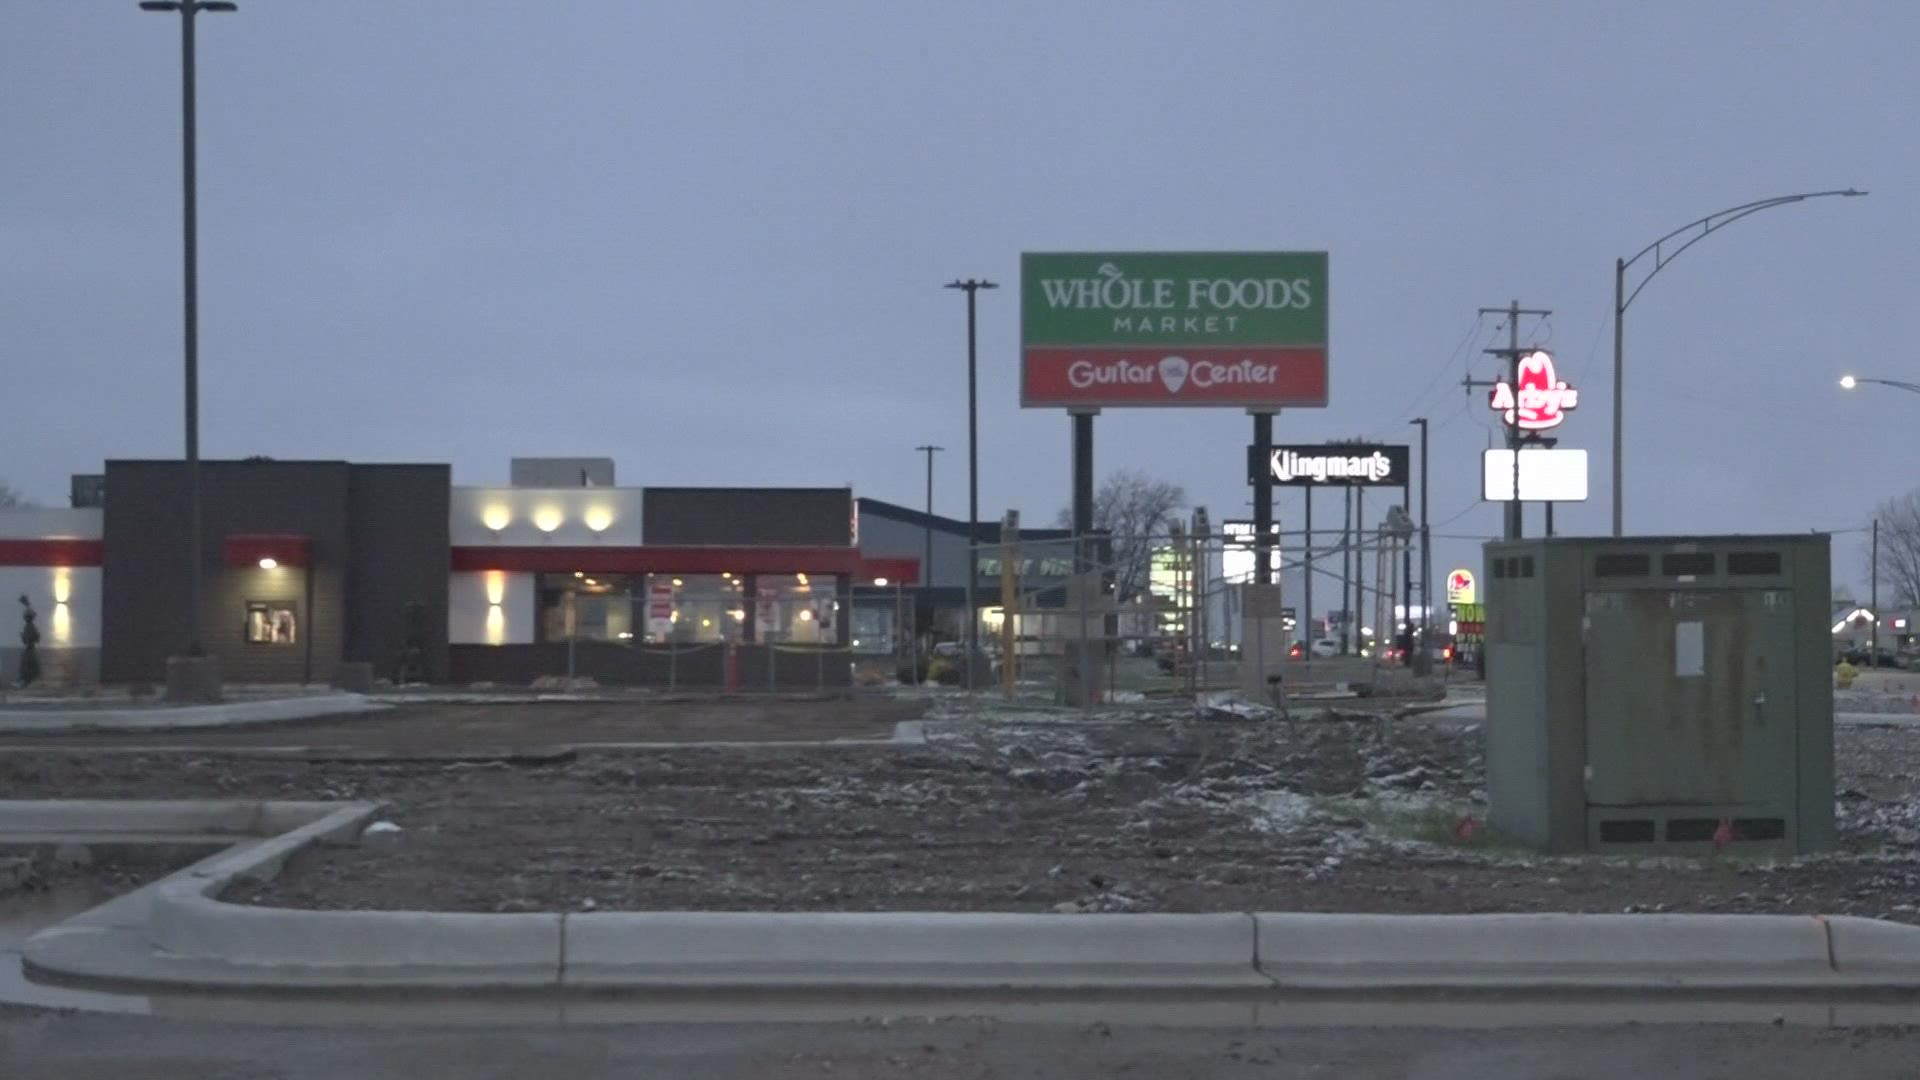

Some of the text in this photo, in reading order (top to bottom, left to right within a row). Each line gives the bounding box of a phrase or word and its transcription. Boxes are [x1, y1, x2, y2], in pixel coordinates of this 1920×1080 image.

[1040, 276, 1311, 310] WHOLE FOODS
[1113, 316, 1240, 333] MARKET
[1067, 359, 1278, 389] Guitar Center
[1270, 449, 1391, 482] Klingman's
